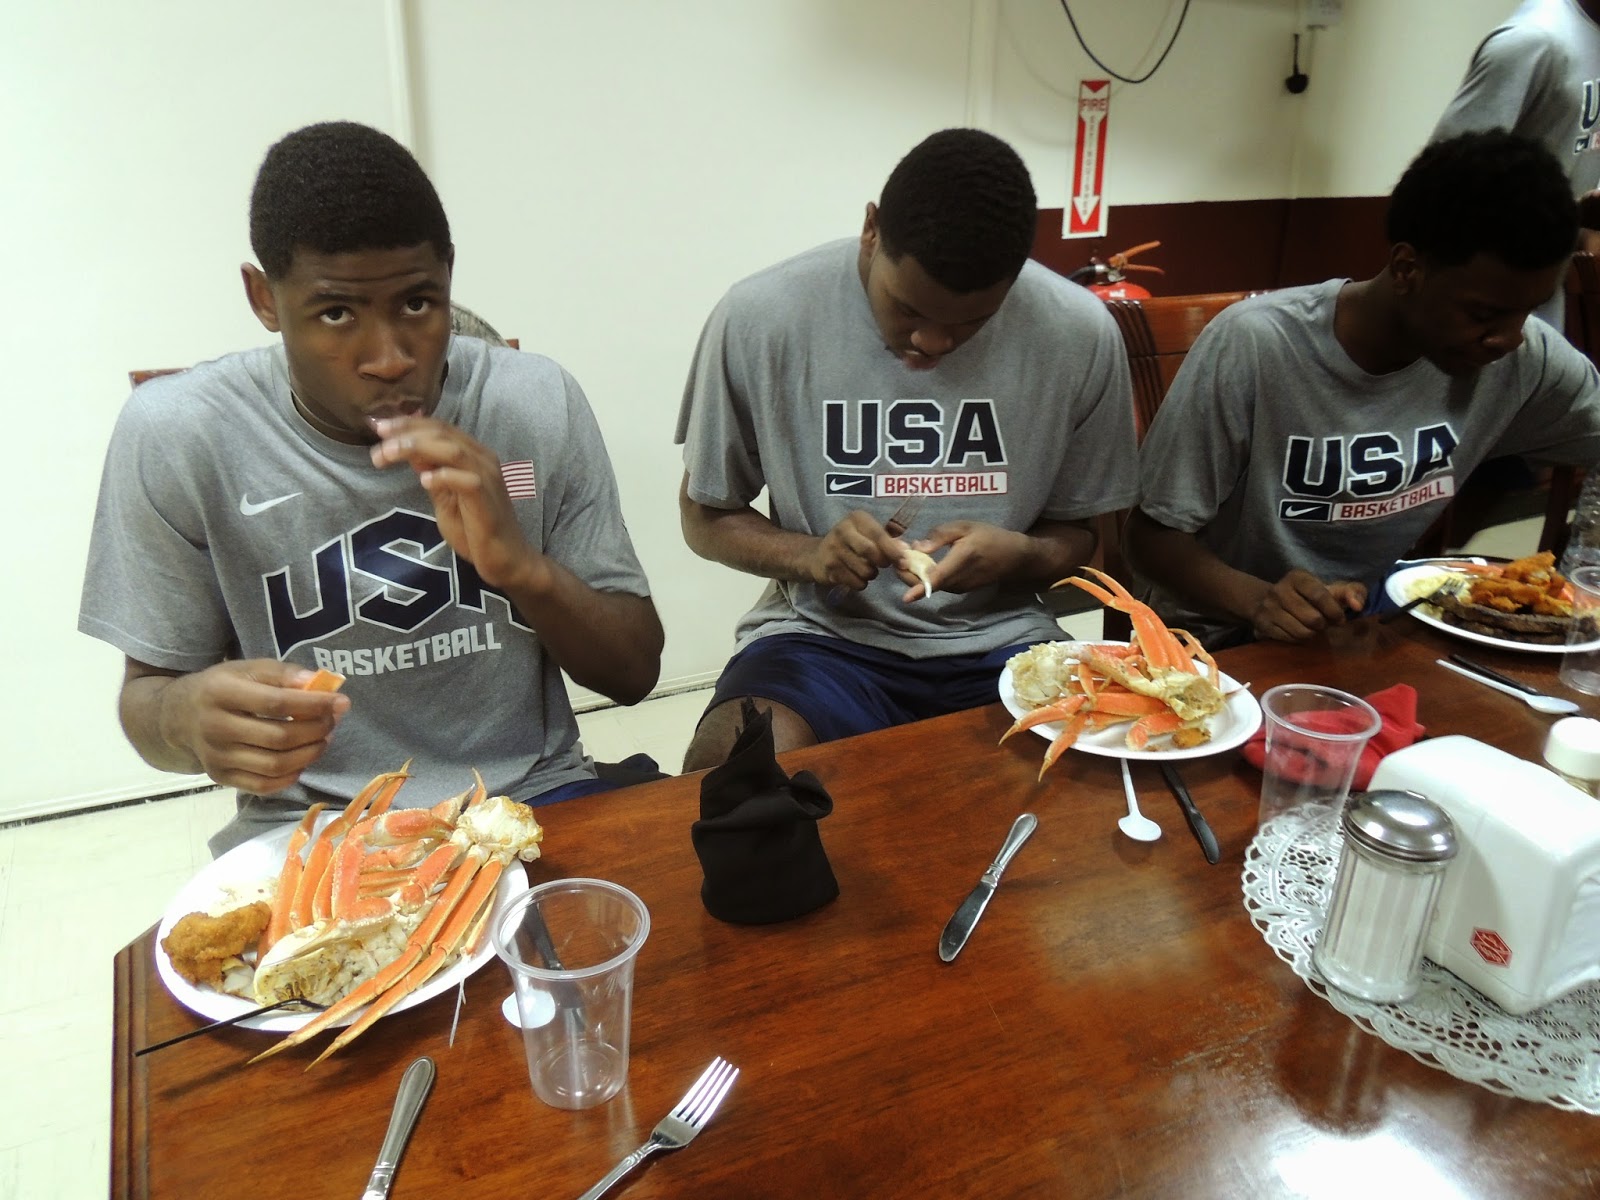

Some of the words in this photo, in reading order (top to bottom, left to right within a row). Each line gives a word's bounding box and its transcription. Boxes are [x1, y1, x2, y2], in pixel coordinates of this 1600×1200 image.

[1078, 98, 1107, 111] FIRE
[823, 399, 1008, 468] USA
[1282, 422, 1460, 498] USA
[884, 475, 998, 494] BASKETBALL
[1340, 484, 1446, 519] BASKETBALL
[313, 622, 502, 677] BASKETBALL
